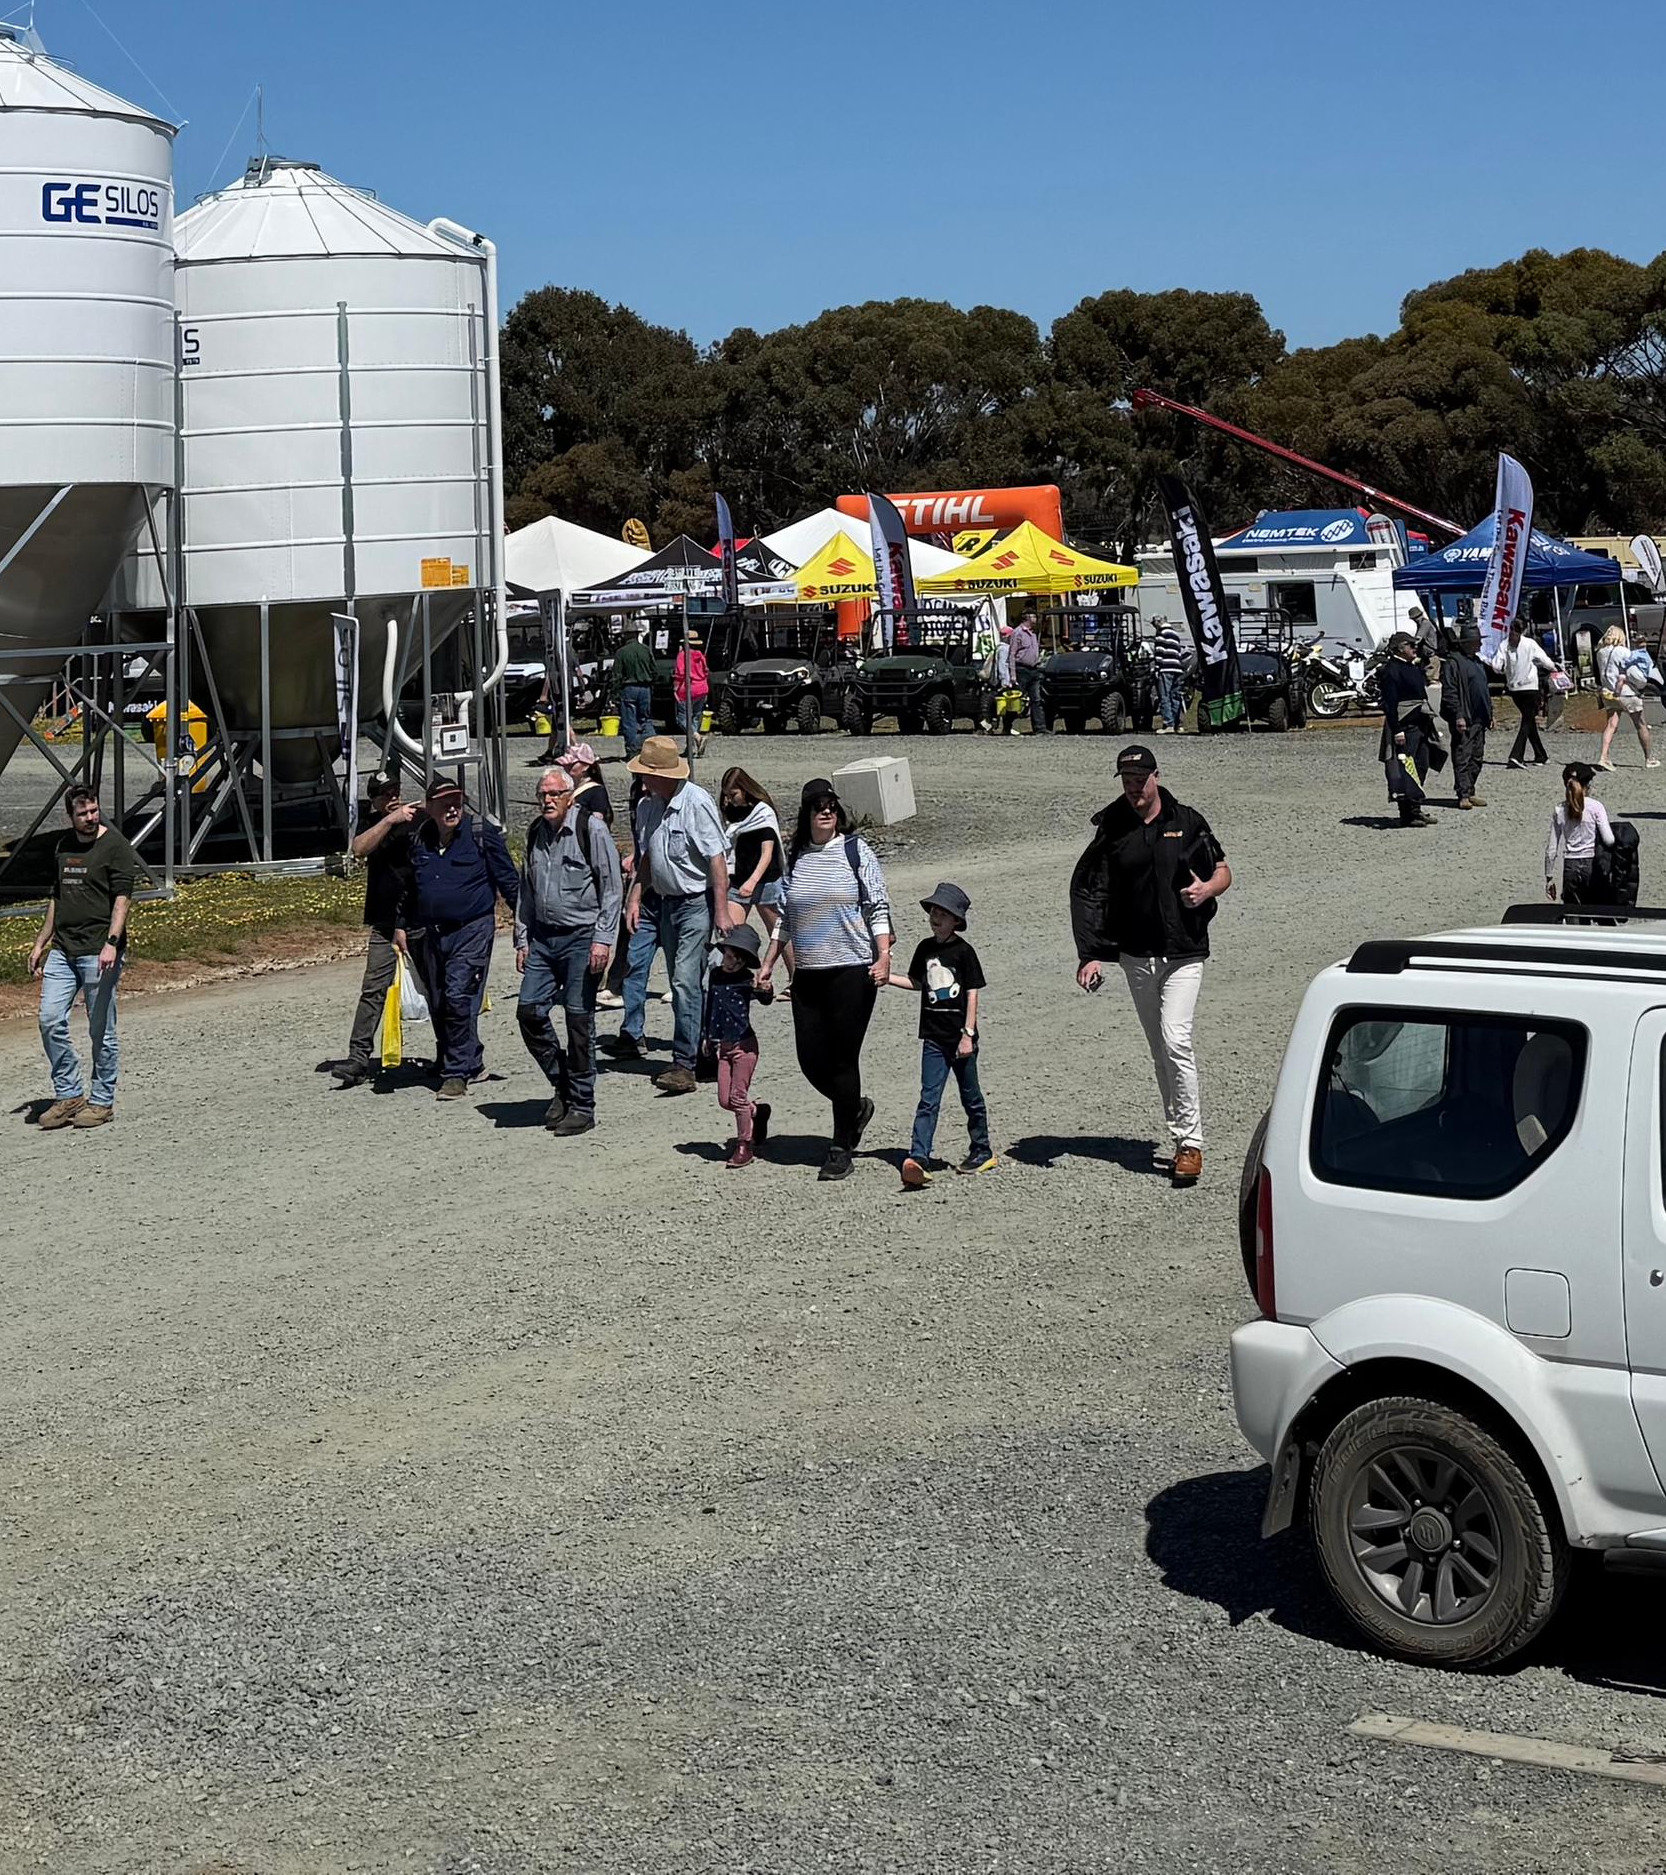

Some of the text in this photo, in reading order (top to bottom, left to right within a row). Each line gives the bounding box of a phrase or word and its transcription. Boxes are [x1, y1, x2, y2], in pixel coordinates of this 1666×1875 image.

[42, 182, 159, 224] GE SILOS
[1462, 547, 1494, 559] YAM
[967, 579, 1018, 589] SUZUKI
[1084, 575, 1118, 585] SUZUKI
[1491, 508, 1526, 633] Kawasaki
[1172, 505, 1228, 665] Kawasaki
